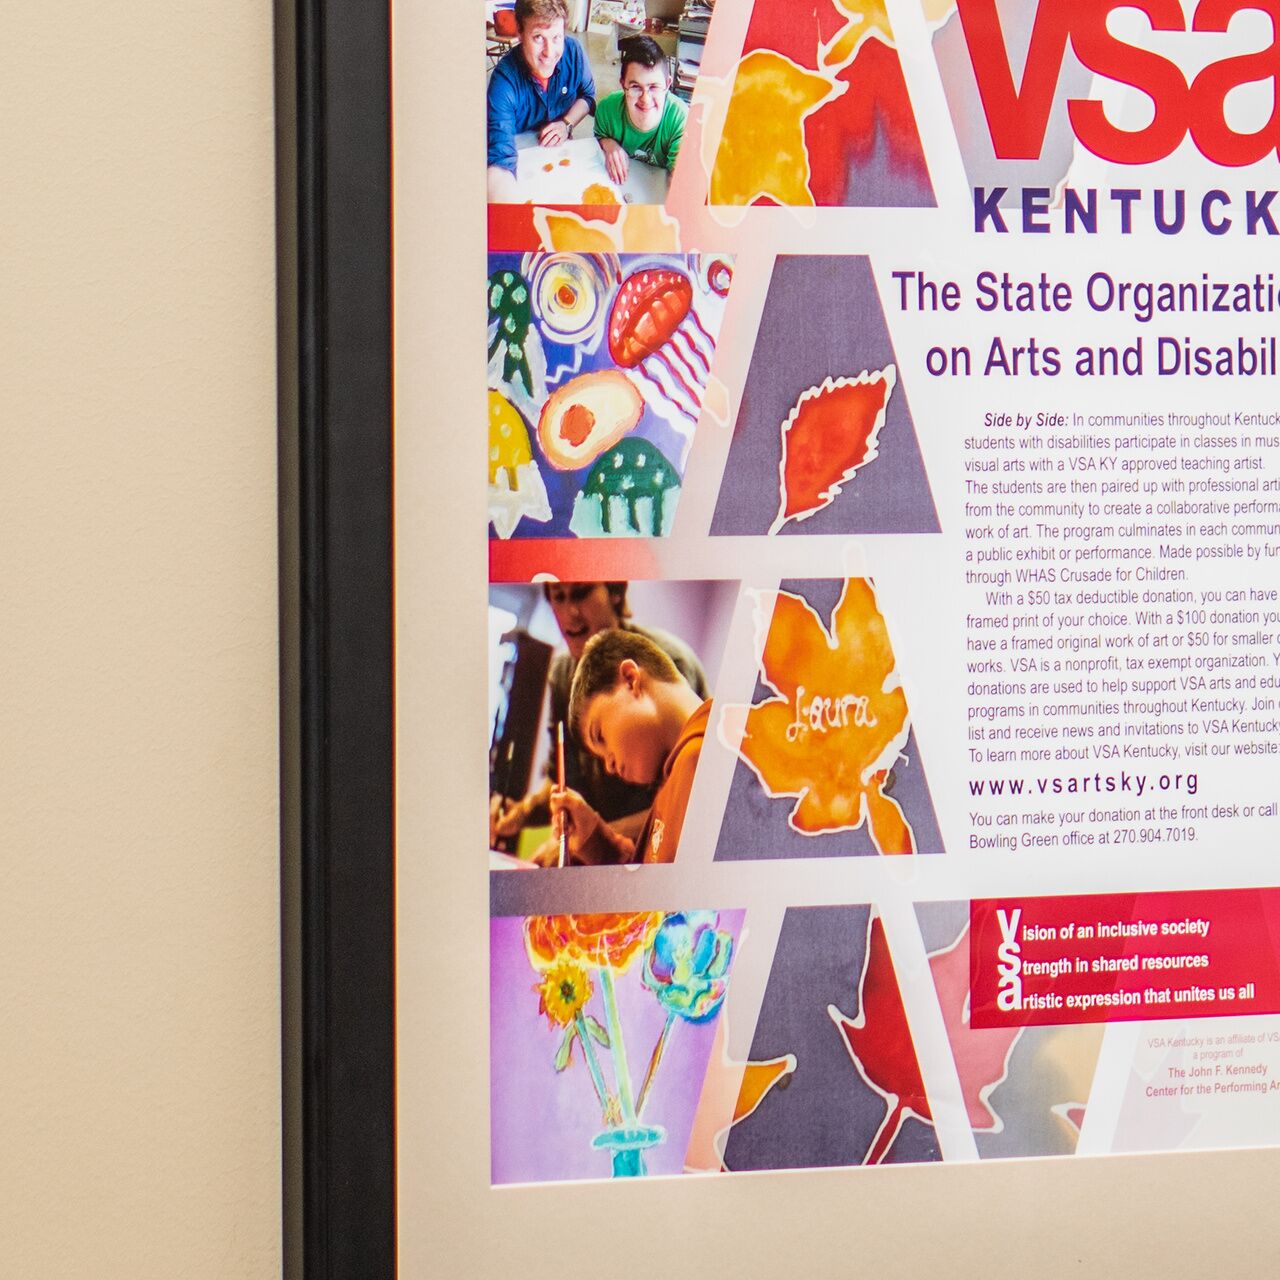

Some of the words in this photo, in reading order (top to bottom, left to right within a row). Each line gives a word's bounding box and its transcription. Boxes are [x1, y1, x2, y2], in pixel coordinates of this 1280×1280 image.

[892, 271, 961, 312] The
[975, 272, 1072, 313] State
[926, 341, 971, 376] on
[984, 337, 1061, 376] Arts
[1075, 337, 1143, 376] and
[984, 413, 1012, 428] Side
[1016, 413, 1032, 430] by
[1036, 413, 1069, 428] Side:
[1073, 413, 1084, 427] In
[1088, 413, 1164, 427] communities
[1168, 412, 1231, 429] throughout
[965, 435, 1015, 450] students
[1019, 435, 1043, 449] with
[1047, 434, 1111, 450] disabilities
[1114, 434, 1176, 451] participate
[1180, 434, 1190, 448] in
[1194, 434, 1237, 448] classes
[1241, 434, 1251, 448] in
[966, 568, 1012, 587] through
[1016, 568, 1056, 583] WHAS
[1060, 567, 1112, 582] Crusade
[1116, 567, 1132, 582] for
[1136, 566, 1188, 581] Children.
[985, 591, 1013, 606] With
[1016, 595, 1024, 606] a
[1028, 590, 1050, 606] $50
[1054, 592, 1073, 605] tax
[1076, 589, 1139, 605] deductible
[1142, 589, 1196, 605] donation,
[1201, 591, 1221, 606] you
[1225, 590, 1246, 603] can
[1250, 587, 1277, 602] have
[786, 686, 877, 742] Laura
[969, 771, 1199, 797] www.vsartsky.org
[969, 811, 992, 827] You
[996, 813, 1017, 826] can
[1022, 810, 1055, 825] make
[1058, 812, 1084, 828] your
[1088, 808, 1140, 824] donation
[1145, 809, 1156, 821] at
[1159, 807, 1177, 820] the
[1181, 806, 1208, 820] front
[1212, 805, 1239, 819] desk
[1242, 807, 1254, 819] or
[1258, 803, 1277, 817] call
[970, 834, 1017, 851] Bowling
[1021, 832, 1058, 847] Green
[1062, 830, 1095, 846] office
[1098, 832, 1110, 845] at
[1060, 923, 1074, 940] of
[1078, 925, 1093, 938] an
[1097, 920, 1158, 938] inclusive
[1161, 919, 1209, 937] society
[1076, 956, 1088, 972] in
[1092, 954, 1138, 971] shared
[1142, 953, 1209, 970] resources
[1066, 989, 1141, 1010] expression
[1145, 988, 1170, 1004] that
[1174, 986, 1215, 1002] unites
[1219, 987, 1234, 1001] us
[1238, 984, 1254, 999] all
[1148, 1038, 1165, 1048] VSA
[1167, 1035, 1204, 1050] Kentucky
[1207, 1035, 1212, 1045] is
[1215, 1036, 1225, 1045] an
[1257, 1033, 1264, 1044] of
[1193, 1052, 1197, 1060] a
[1199, 1049, 1232, 1061] program
[1235, 1047, 1243, 1058] of
[1168, 1067, 1185, 1078] The
[1189, 1066, 1212, 1078] John
[1216, 1065, 1222, 1076] F.
[1226, 1063, 1267, 1078] Kennedy
[1146, 1085, 1176, 1097] Center
[1180, 1083, 1194, 1096] for
[1196, 1083, 1211, 1094] the
[1214, 1081, 1267, 1096] Performing
